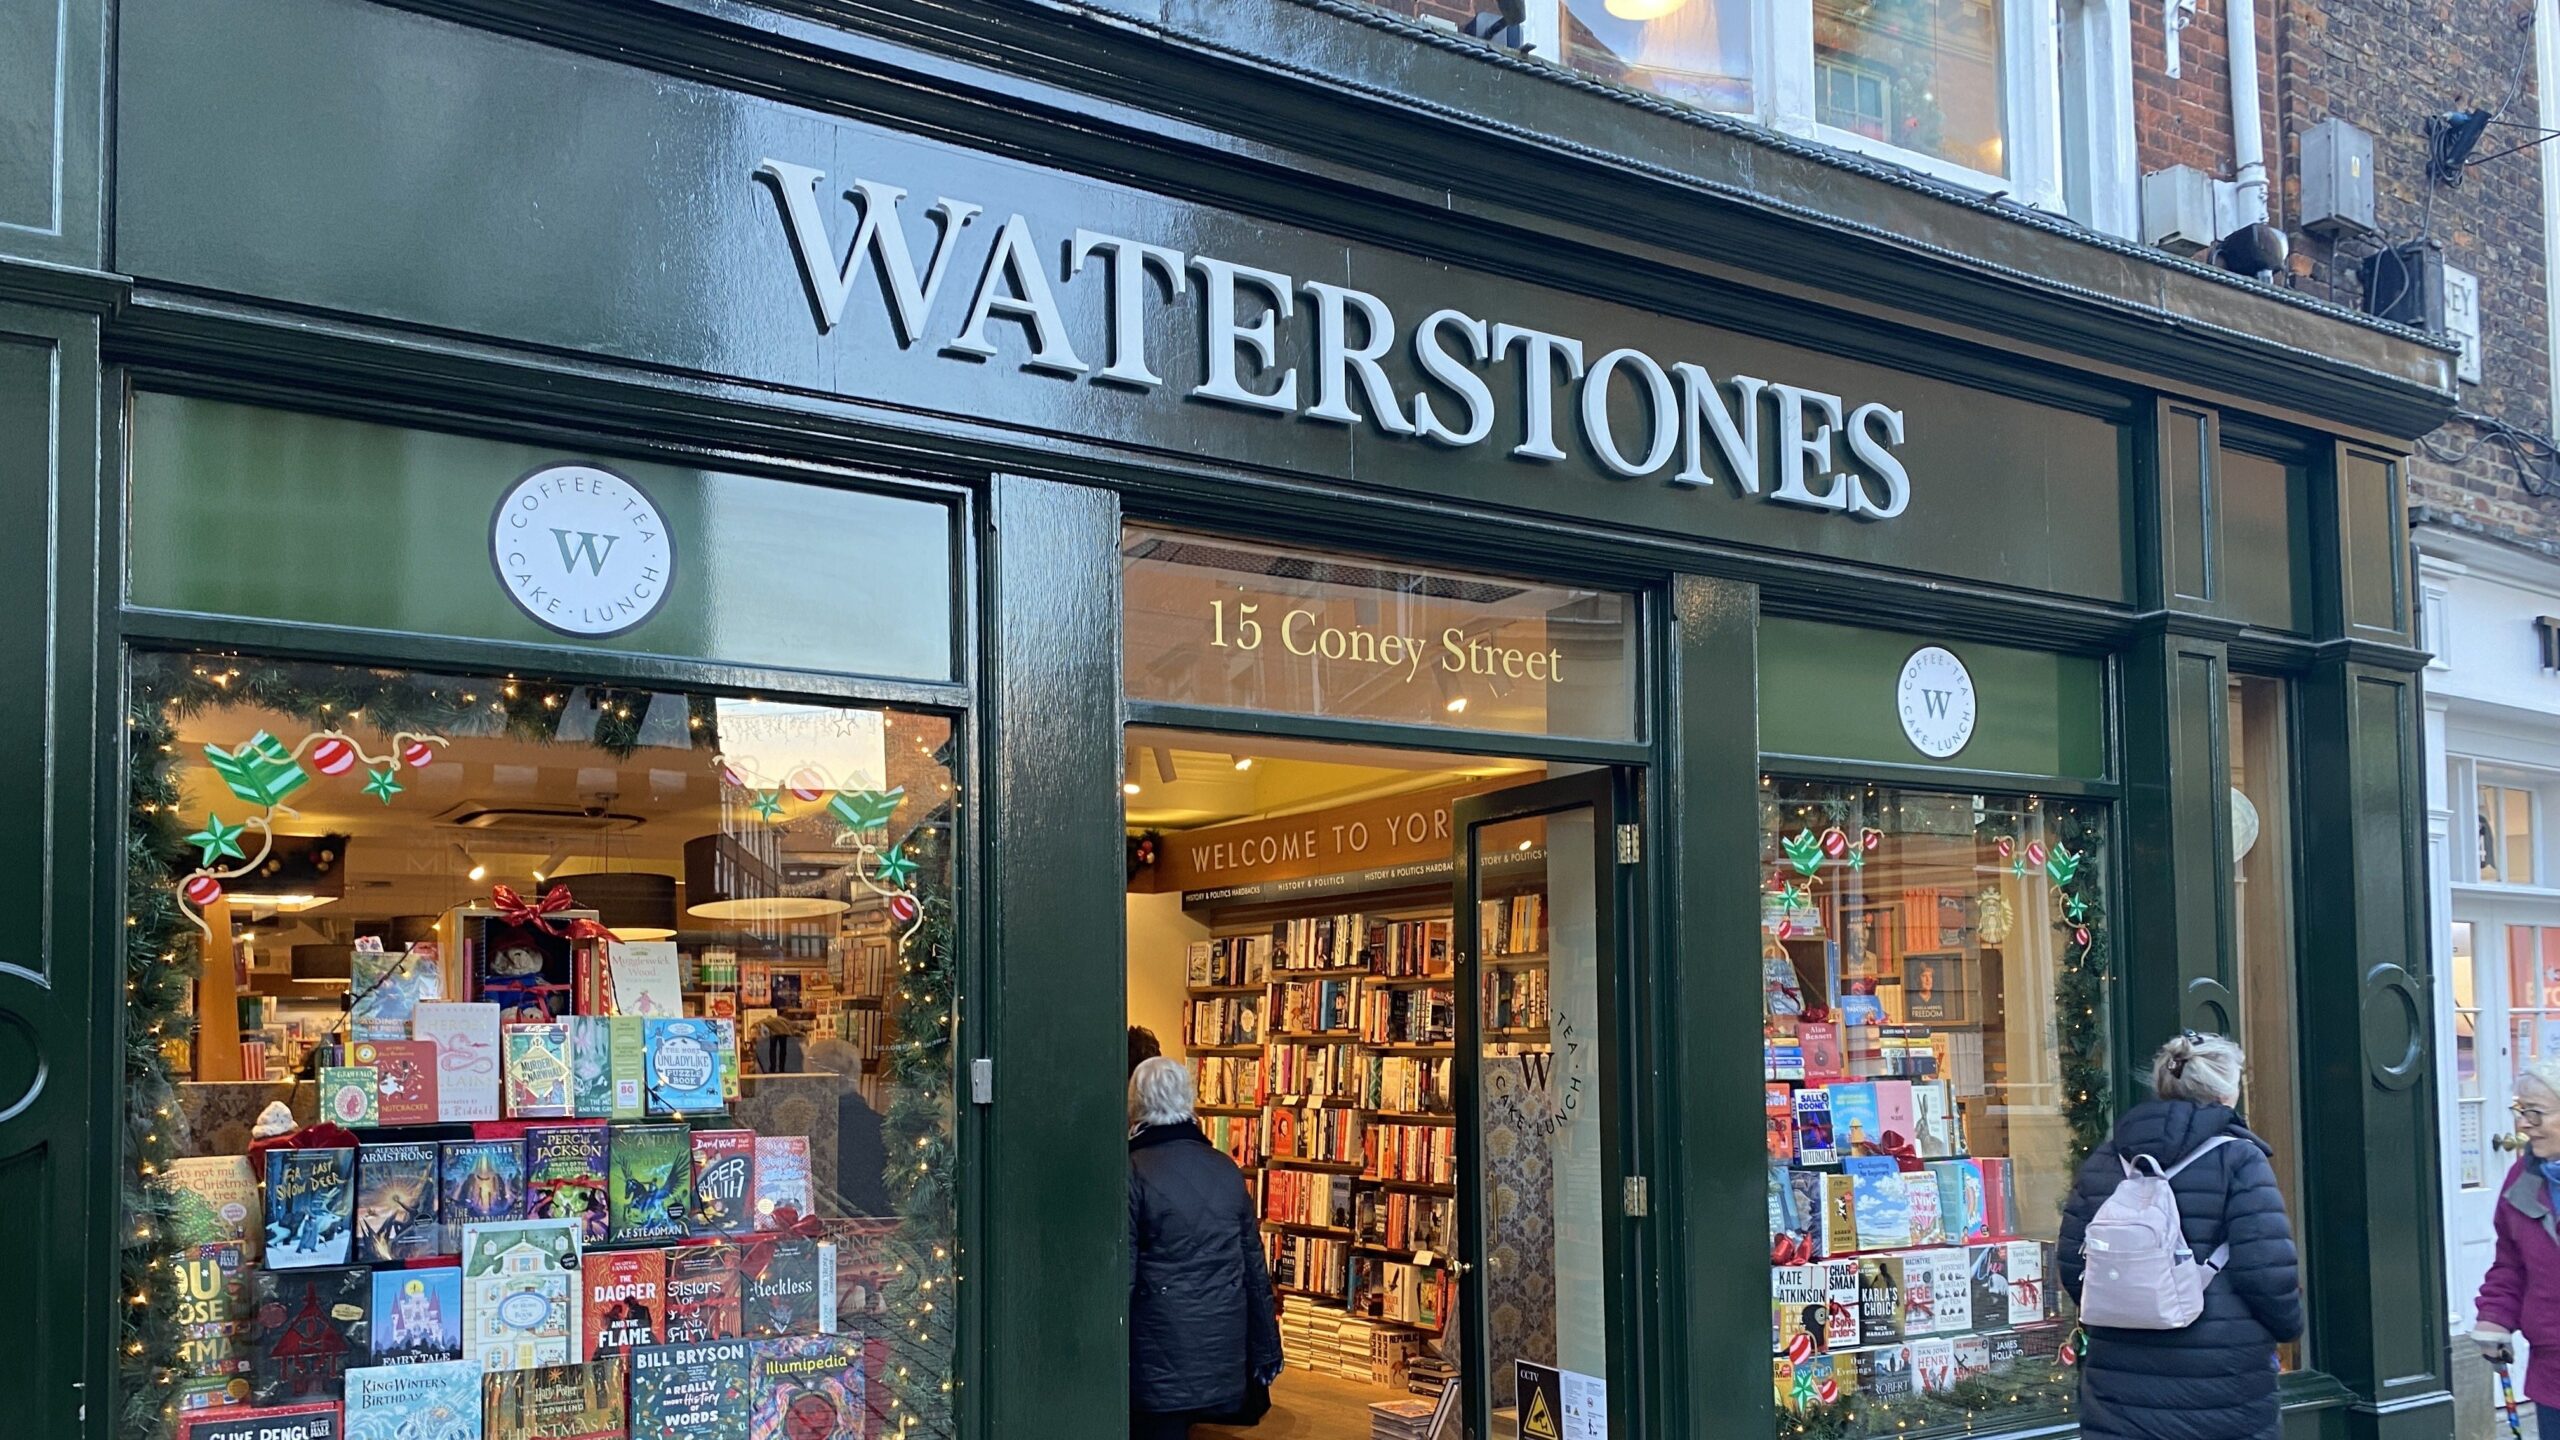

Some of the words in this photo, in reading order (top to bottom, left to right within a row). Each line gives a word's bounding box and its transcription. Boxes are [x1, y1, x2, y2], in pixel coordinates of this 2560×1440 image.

[757, 157, 1911, 521] WATERSTONES
[511, 477, 603, 528] COFFEE
[622, 498, 656, 543] TEA
[549, 528, 620, 577] W
[509, 552, 561, 614] CAKE
[584, 566, 659, 623] LUNCH
[1209, 600, 1262, 650] 15
[1281, 610, 1426, 683] Coney
[1441, 628, 1564, 683] Street
[1904, 653, 1944, 691] COFFEE
[1953, 667, 1969, 697] TEA
[1921, 688, 1953, 721] W
[1904, 705, 1929, 746] CAKE
[1938, 711, 1971, 751] LUNCH
[1191, 828, 1317, 873] WELCOME
[1332, 820, 1368, 855] TO
[1386, 808, 1449, 846] YOR
[1481, 854, 1501, 866] STORY
[1503, 854, 1508, 864] &
[1511, 850, 1542, 862] POLITICS
[1365, 868, 1388, 880] HISTORY
[1390, 869, 1395, 878] &
[1397, 864, 1424, 877] POLITICS
[1425, 861, 1453, 873] HARDBAC
[1278, 881, 1304, 891] HISTORY
[1307, 880, 1312, 888] &
[1314, 875, 1345, 887] POLITICS
[1185, 892, 1204, 902] HISTORY
[1210, 889, 1231, 899] POLITICS
[1231, 886, 1260, 897] HARDBACKS
[612, 955, 670, 967] Muggleswick
[628, 968, 657, 977] Wood
[1911, 1010, 1943, 1018] FREEDOM
[1555, 1012, 1578, 1054] TEA
[657, 1055, 709, 1068] UNLADYLIKE
[666, 1069, 701, 1078] PUZZLE
[1518, 1052, 1555, 1092] W
[673, 1077, 697, 1085] BOOK
[381, 1103, 429, 1113] NUTCRACKER
[1495, 1075, 1525, 1130] CAKE
[1536, 1077, 1581, 1137] LUNCH
[1798, 1101, 1829, 1110] ROONEY
[375, 1145, 419, 1154] ALEXANDER
[455, 1147, 489, 1155] JORDAN
[692, 1139, 717, 1150] David
[719, 1138, 737, 1148] Wall
[361, 1150, 433, 1162] ARMSTRONG
[536, 1145, 602, 1164] JACKSON
[194, 1169, 215, 1178] not
[311, 1160, 334, 1176] LAST
[698, 1158, 745, 1190] SUPER
[276, 1183, 307, 1200] SNOW
[311, 1173, 347, 1191] DEER
[213, 1191, 237, 1200] tree
[454, 1207, 468, 1218] THE
[632, 1225, 682, 1237] STEADMAN
[1829, 1264, 1851, 1276] CHAR
[620, 1275, 631, 1283] THE
[1779, 1271, 1802, 1285] KATE
[1829, 1276, 1855, 1290] SMAN
[1906, 1274, 1920, 1282] THE
[594, 1283, 655, 1302] DAGGER
[667, 1281, 721, 1297] Sisters
[751, 1278, 813, 1299] Reckless
[1779, 1289, 1825, 1303] ATKINSON
[1861, 1287, 1898, 1302] KARLA'S
[1904, 1285, 1930, 1301] IEGE
[682, 1296, 694, 1305] OF
[177, 1300, 224, 1325] OSE
[1864, 1302, 1897, 1316] CHOICE
[611, 1320, 624, 1328] AND
[626, 1319, 638, 1327] THE
[682, 1320, 703, 1329] AND
[599, 1328, 650, 1348] FLAME
[667, 1327, 708, 1342] Fury
[1389, 1333, 1419, 1344] REPUBLIC
[1829, 1328, 1856, 1338] urders
[1996, 1340, 2018, 1349] JAMES
[383, 1354, 415, 1366] FAIRY
[420, 1352, 450, 1363] TALE
[637, 1351, 670, 1369] BILL
[676, 1344, 744, 1364] BRYSON
[766, 1353, 847, 1375] Illumipedia
[1850, 1357, 1865, 1365] Our
[1917, 1355, 1950, 1367] HENRY
[1520, 1369, 1539, 1382] CCTV
[1836, 1366, 1872, 1376] Evenings
[362, 1380, 393, 1394] KING
[398, 1377, 447, 1391] WINTER'S
[535, 1386, 556, 1401] Harry
[556, 1383, 579, 1397] Potter
[665, 1386, 672, 1394] A
[674, 1380, 717, 1395] REALLY
[1875, 1380, 1908, 1395] ROBERT
[362, 1393, 424, 1409] BIRTHDAY
[663, 1398, 683, 1406] SHORT
[684, 1392, 720, 1406] History
[665, 1410, 719, 1426] WORDS
[603, 1421, 618, 1431] AT
